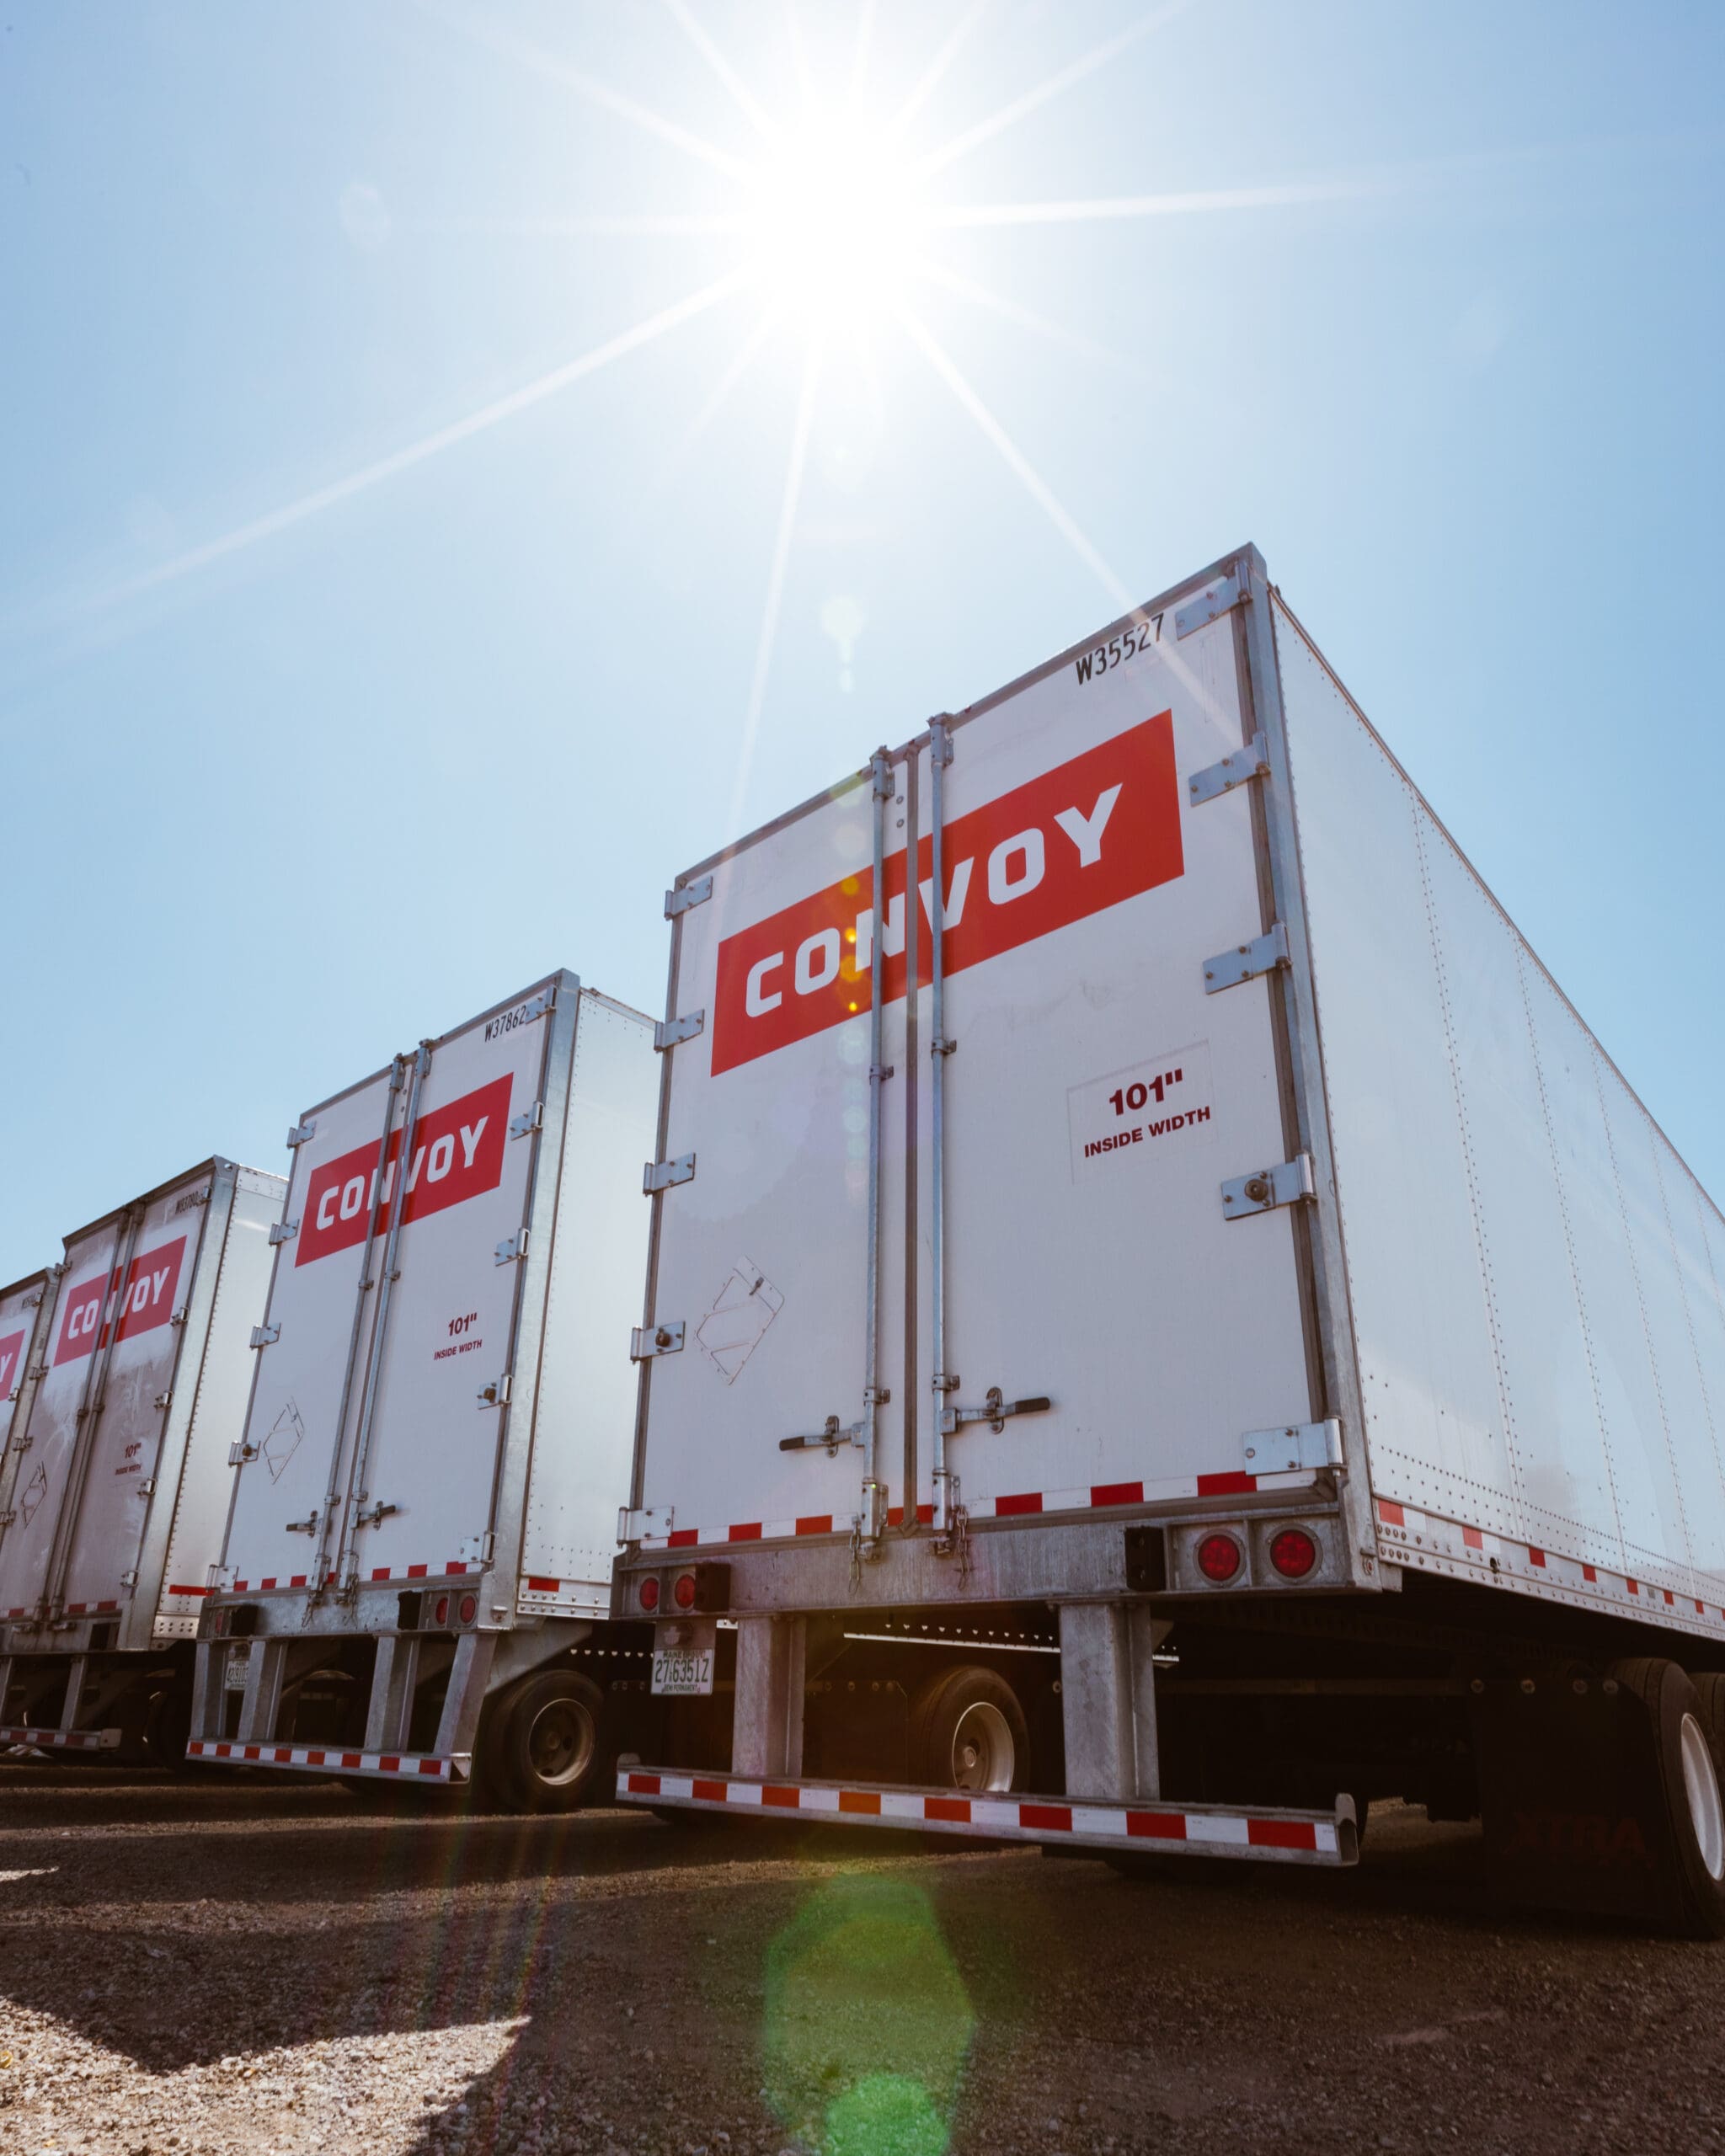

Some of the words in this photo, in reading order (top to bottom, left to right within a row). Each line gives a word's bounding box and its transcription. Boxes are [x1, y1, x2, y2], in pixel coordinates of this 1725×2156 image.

[1076, 612, 1164, 686] W35527
[745, 782, 1124, 1017] CONVOY
[484, 1005, 526, 1043] W37862
[1108, 1068, 1183, 1117] 101"
[1084, 1128, 1143, 1158] INSIDE
[1148, 1106, 1210, 1137] WIDTH
[317, 1115, 489, 1230] CONVOY
[434, 1347, 457, 1360] INSIDE
[459, 1339, 483, 1353] WIDTH
[448, 1312, 477, 1337] 101"
